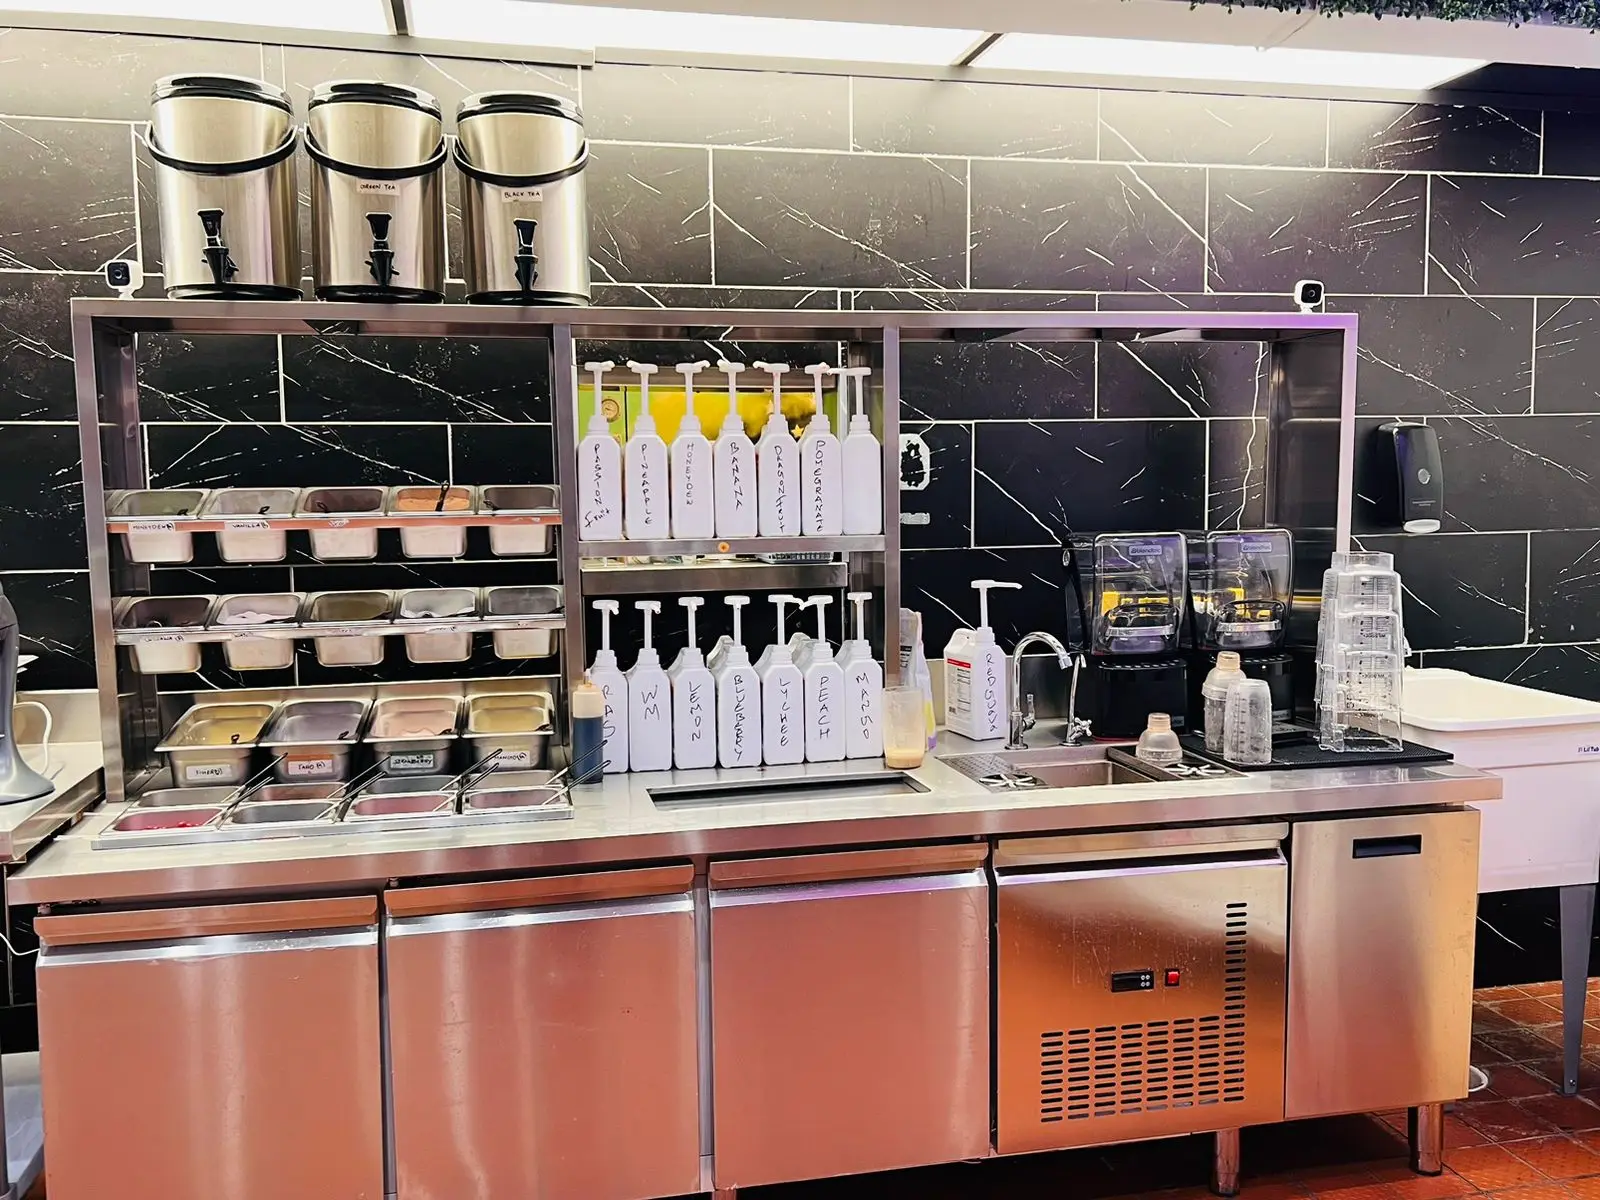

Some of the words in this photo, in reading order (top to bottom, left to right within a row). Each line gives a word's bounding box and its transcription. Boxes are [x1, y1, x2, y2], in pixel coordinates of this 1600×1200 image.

[504, 191, 524, 199] BLACK
[593, 444, 602, 505] PASSION
[641, 444, 653, 525] PINEAPPLE
[730, 442, 743, 510] BANANA
[689, 681, 702, 741] LEMON
[779, 678, 791, 747] LYCHEE
[818, 676, 831, 740] PEACH
[856, 672, 874, 740] MANGO
